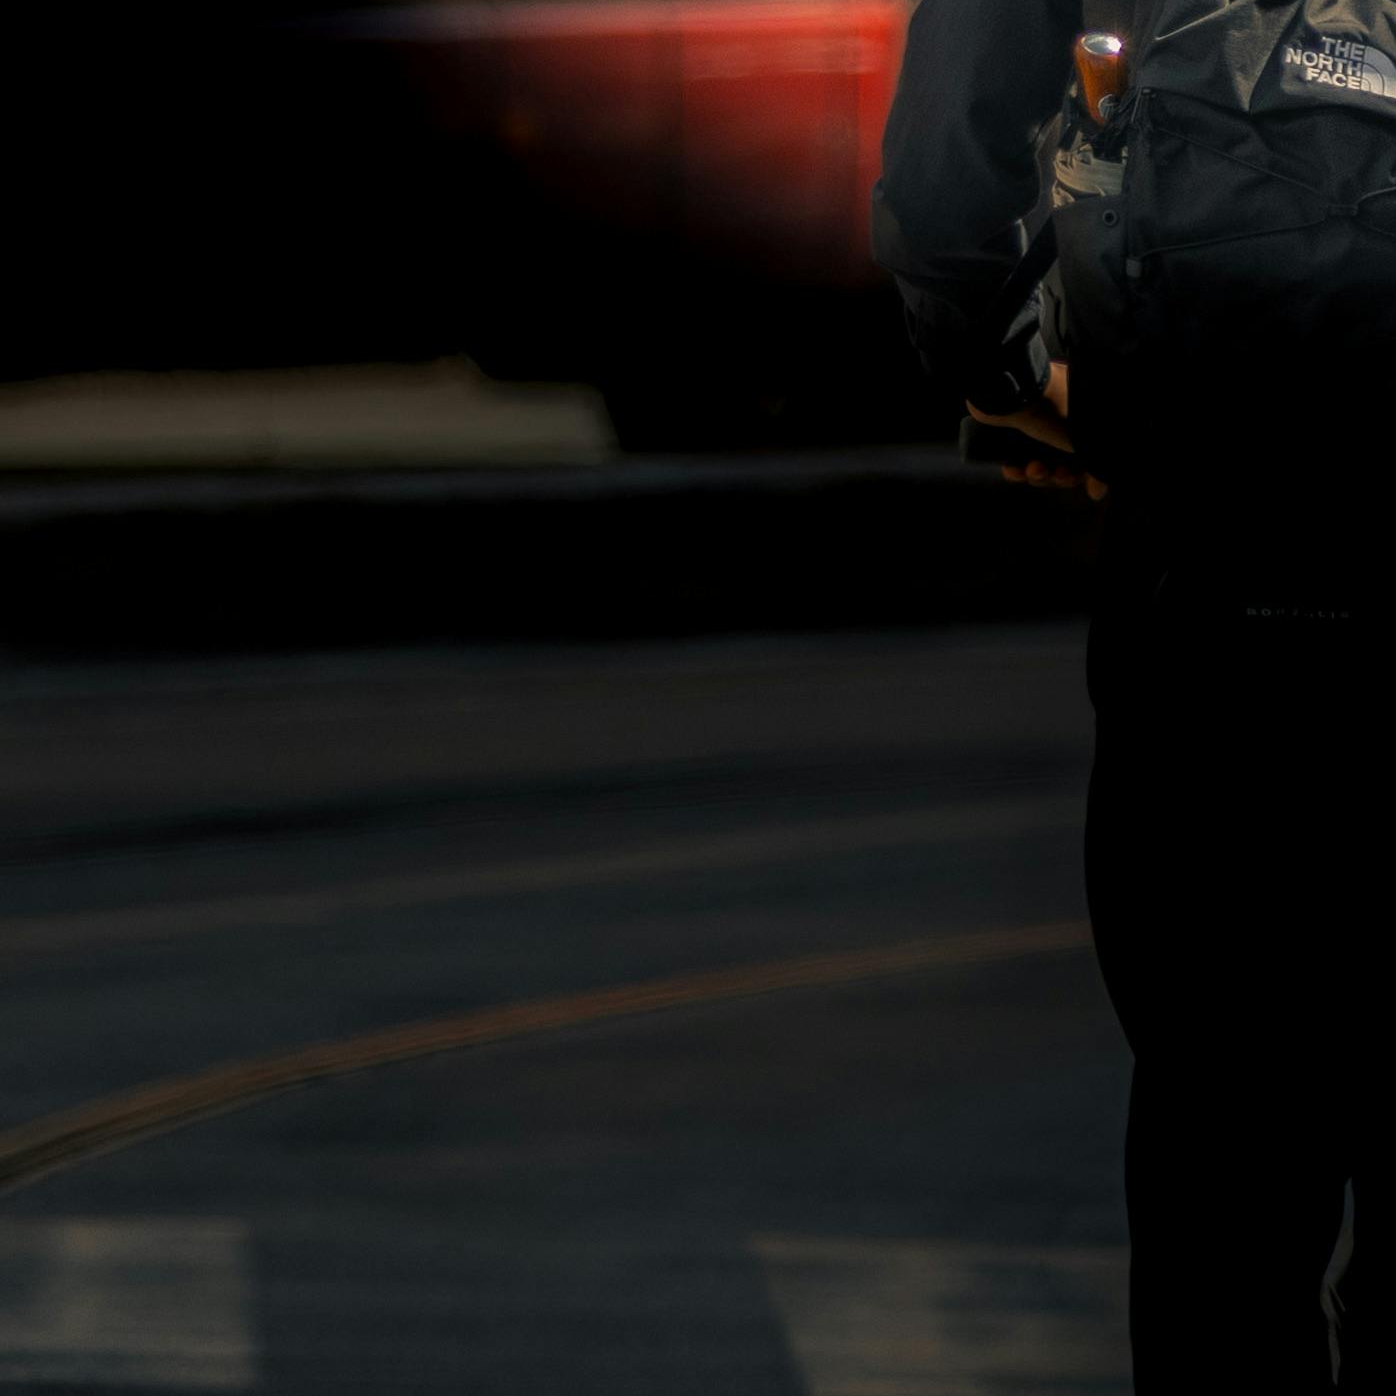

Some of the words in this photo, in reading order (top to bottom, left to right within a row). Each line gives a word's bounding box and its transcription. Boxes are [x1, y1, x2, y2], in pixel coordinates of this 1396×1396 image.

[1322, 36, 1364, 60] THE
[1285, 47, 1362, 76] NORTH
[1305, 67, 1361, 90] FACE
